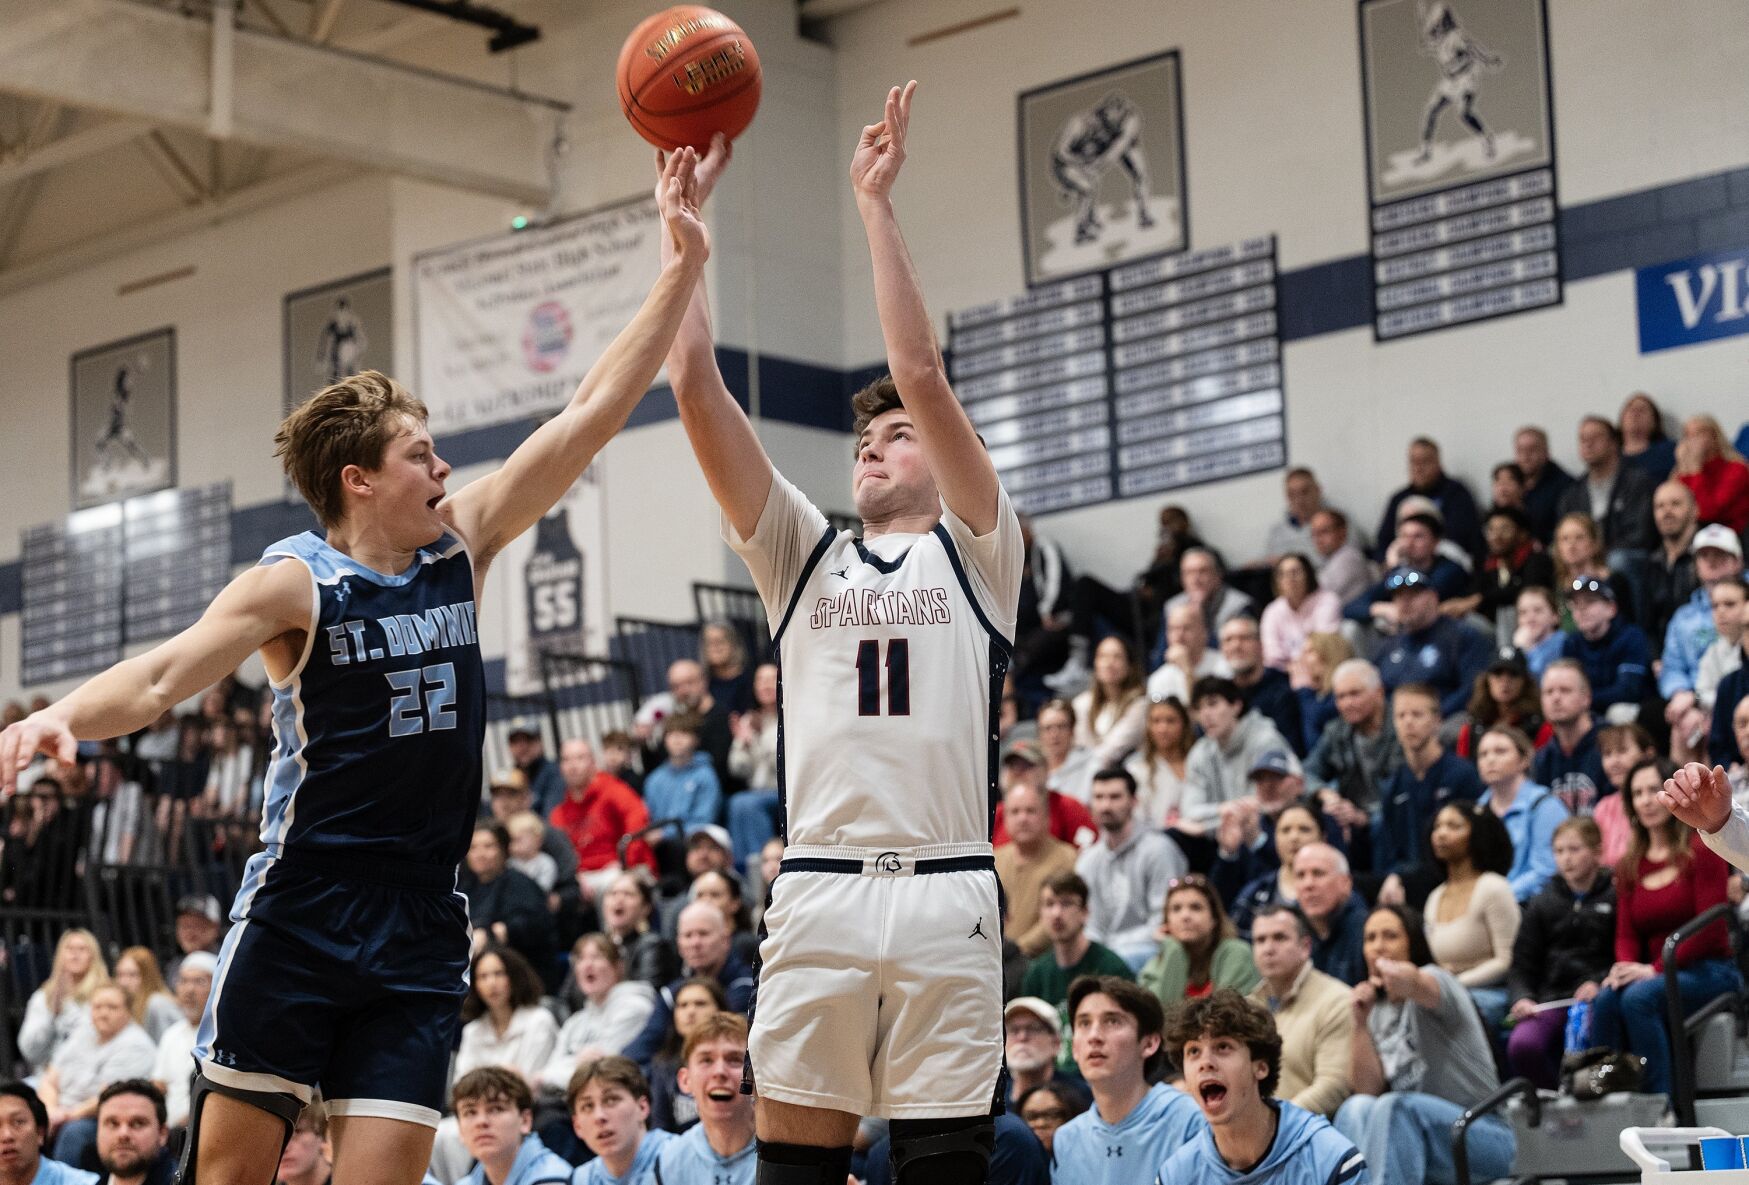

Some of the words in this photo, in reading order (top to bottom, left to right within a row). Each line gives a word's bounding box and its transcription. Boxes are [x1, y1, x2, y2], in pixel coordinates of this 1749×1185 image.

[1664, 259, 1749, 329] VI
[810, 587, 951, 630] SPARTANS
[384, 661, 457, 738] 22
[855, 638, 911, 716] 11
